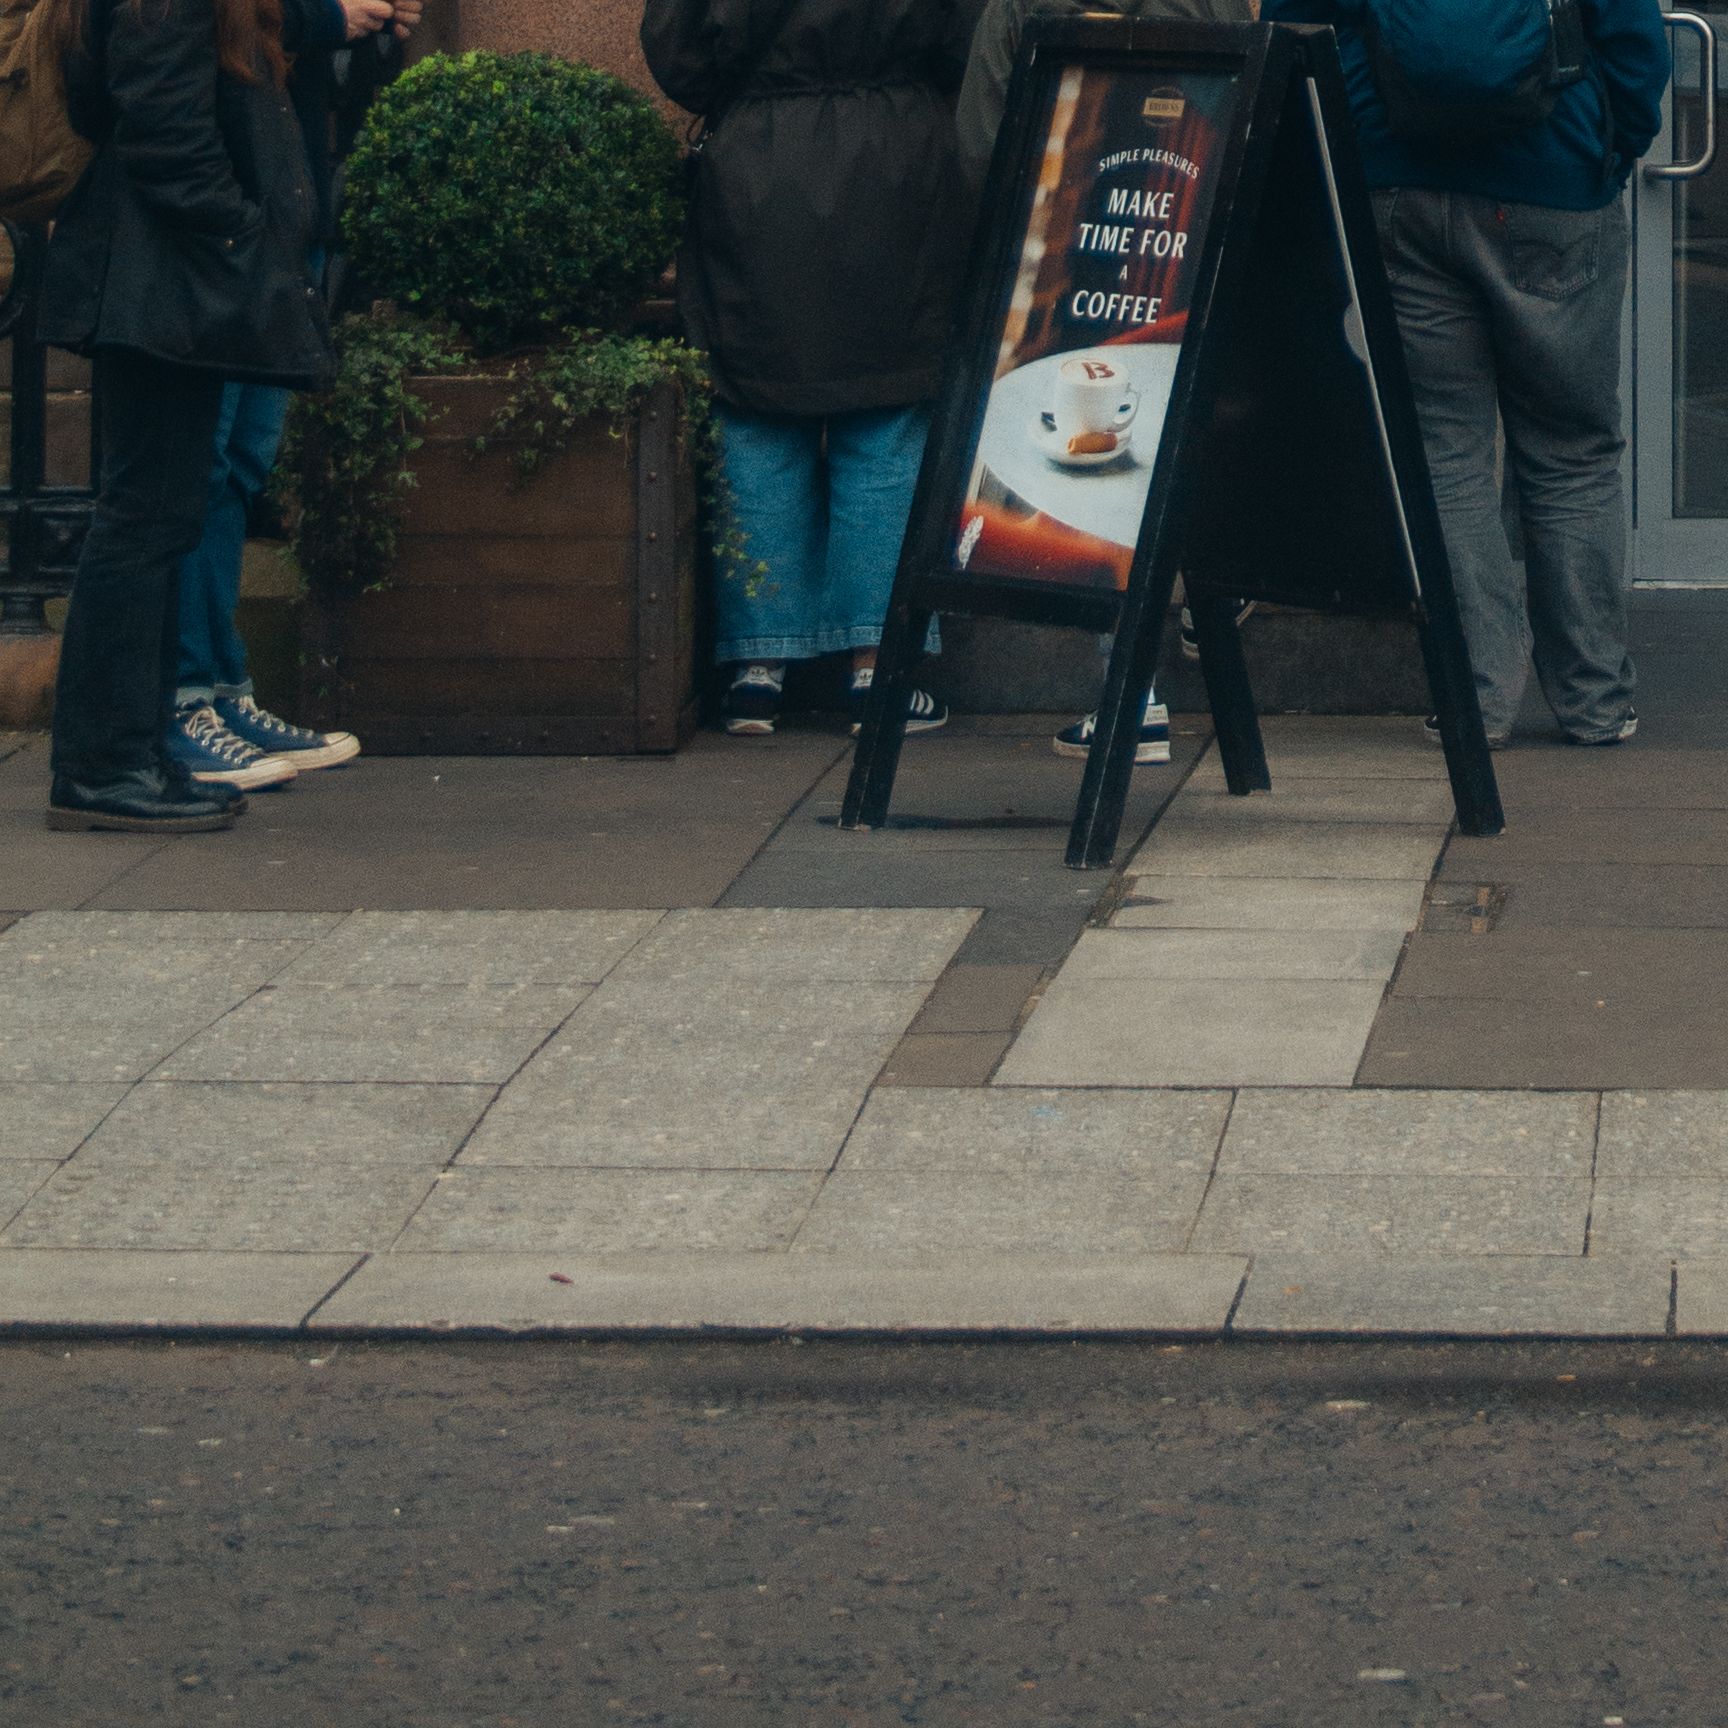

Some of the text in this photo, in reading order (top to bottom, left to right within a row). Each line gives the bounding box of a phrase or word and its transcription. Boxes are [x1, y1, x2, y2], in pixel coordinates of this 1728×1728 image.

[1099, 148, 1200, 179] SIMPLE PLEASURES
[1107, 188, 1174, 218] MAKE
[1079, 223, 1188, 259] TIME FOR
[1119, 265, 1128, 280] A
[1071, 290, 1162, 324] COFFEE
